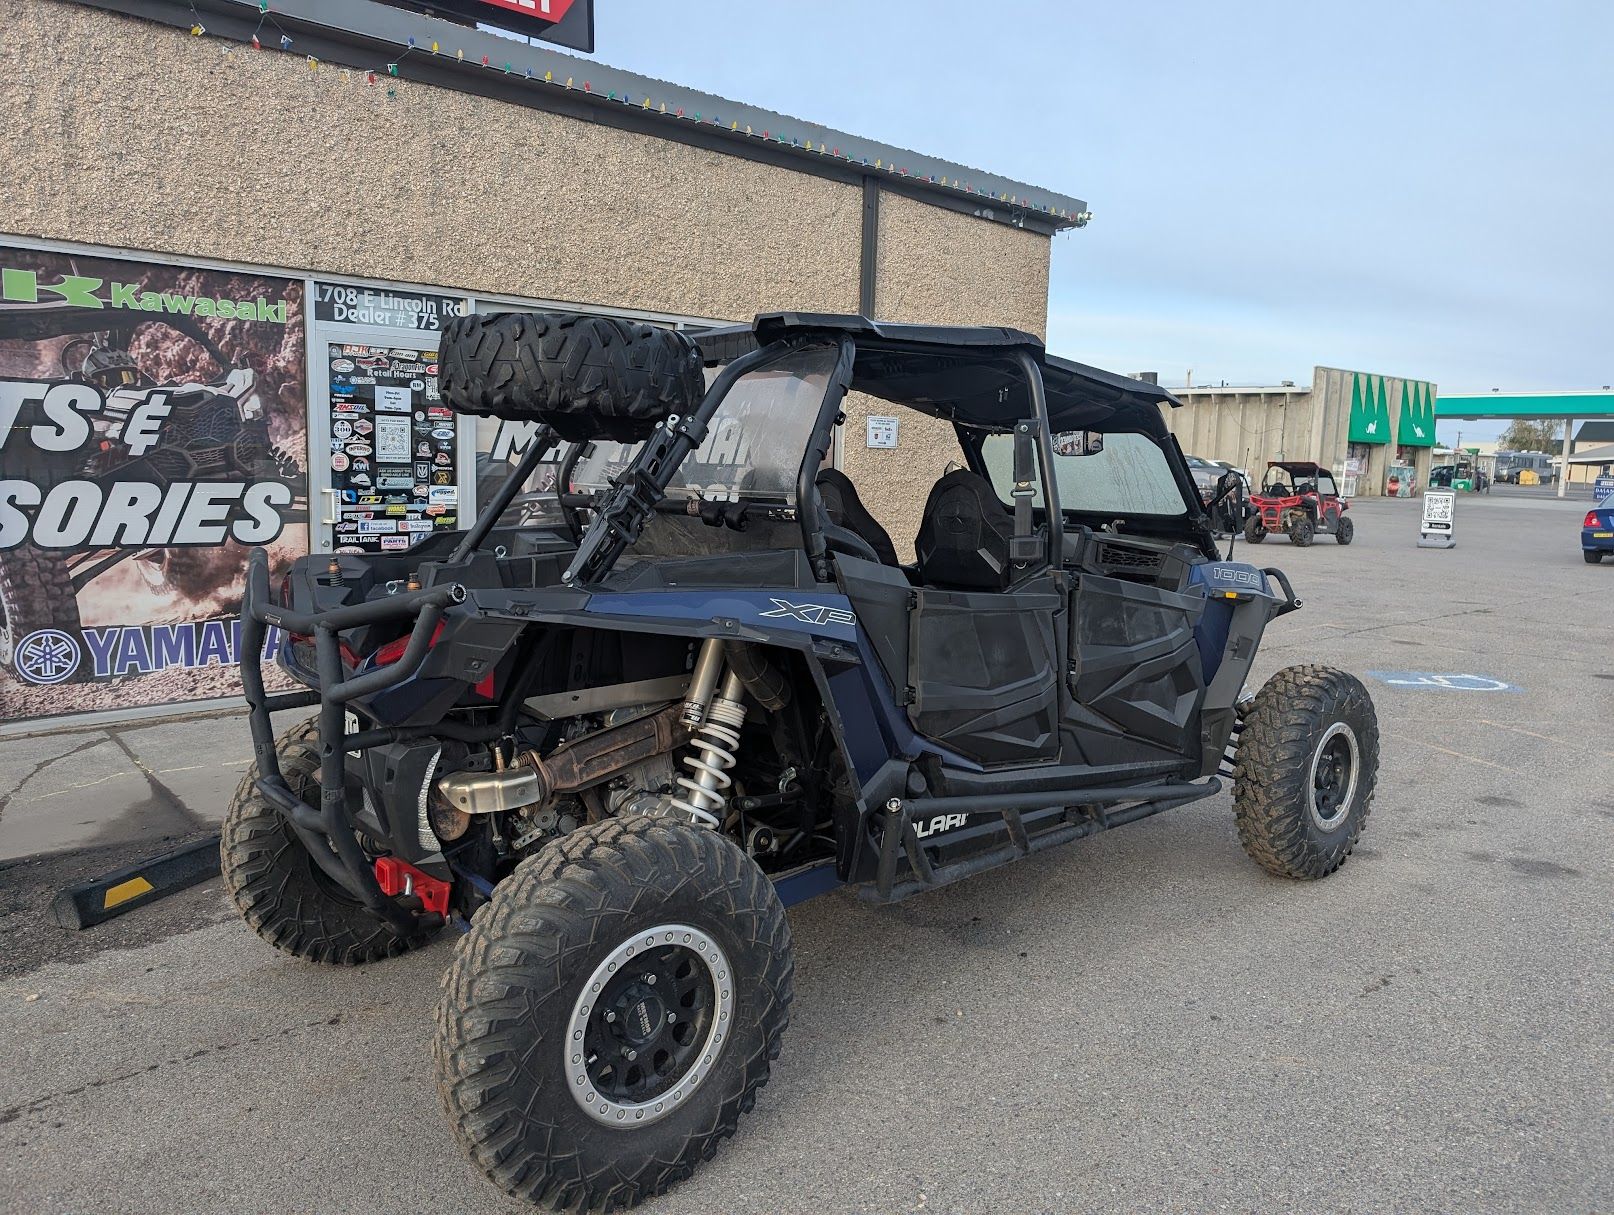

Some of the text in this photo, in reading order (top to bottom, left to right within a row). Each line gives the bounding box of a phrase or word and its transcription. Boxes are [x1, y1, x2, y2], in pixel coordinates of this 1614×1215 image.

[111, 281, 287, 324] Kawasaki
[314, 284, 465, 318] 1708 E Lincoln Rd
[334, 304, 440, 330] Dealer #375
[367, 368, 417, 379] Retail Hours
[336, 403, 366, 411] AMSOIL
[1213, 567, 1260, 587] 1000
[758, 597, 857, 626] XP
[81, 619, 283, 677] YAMA
